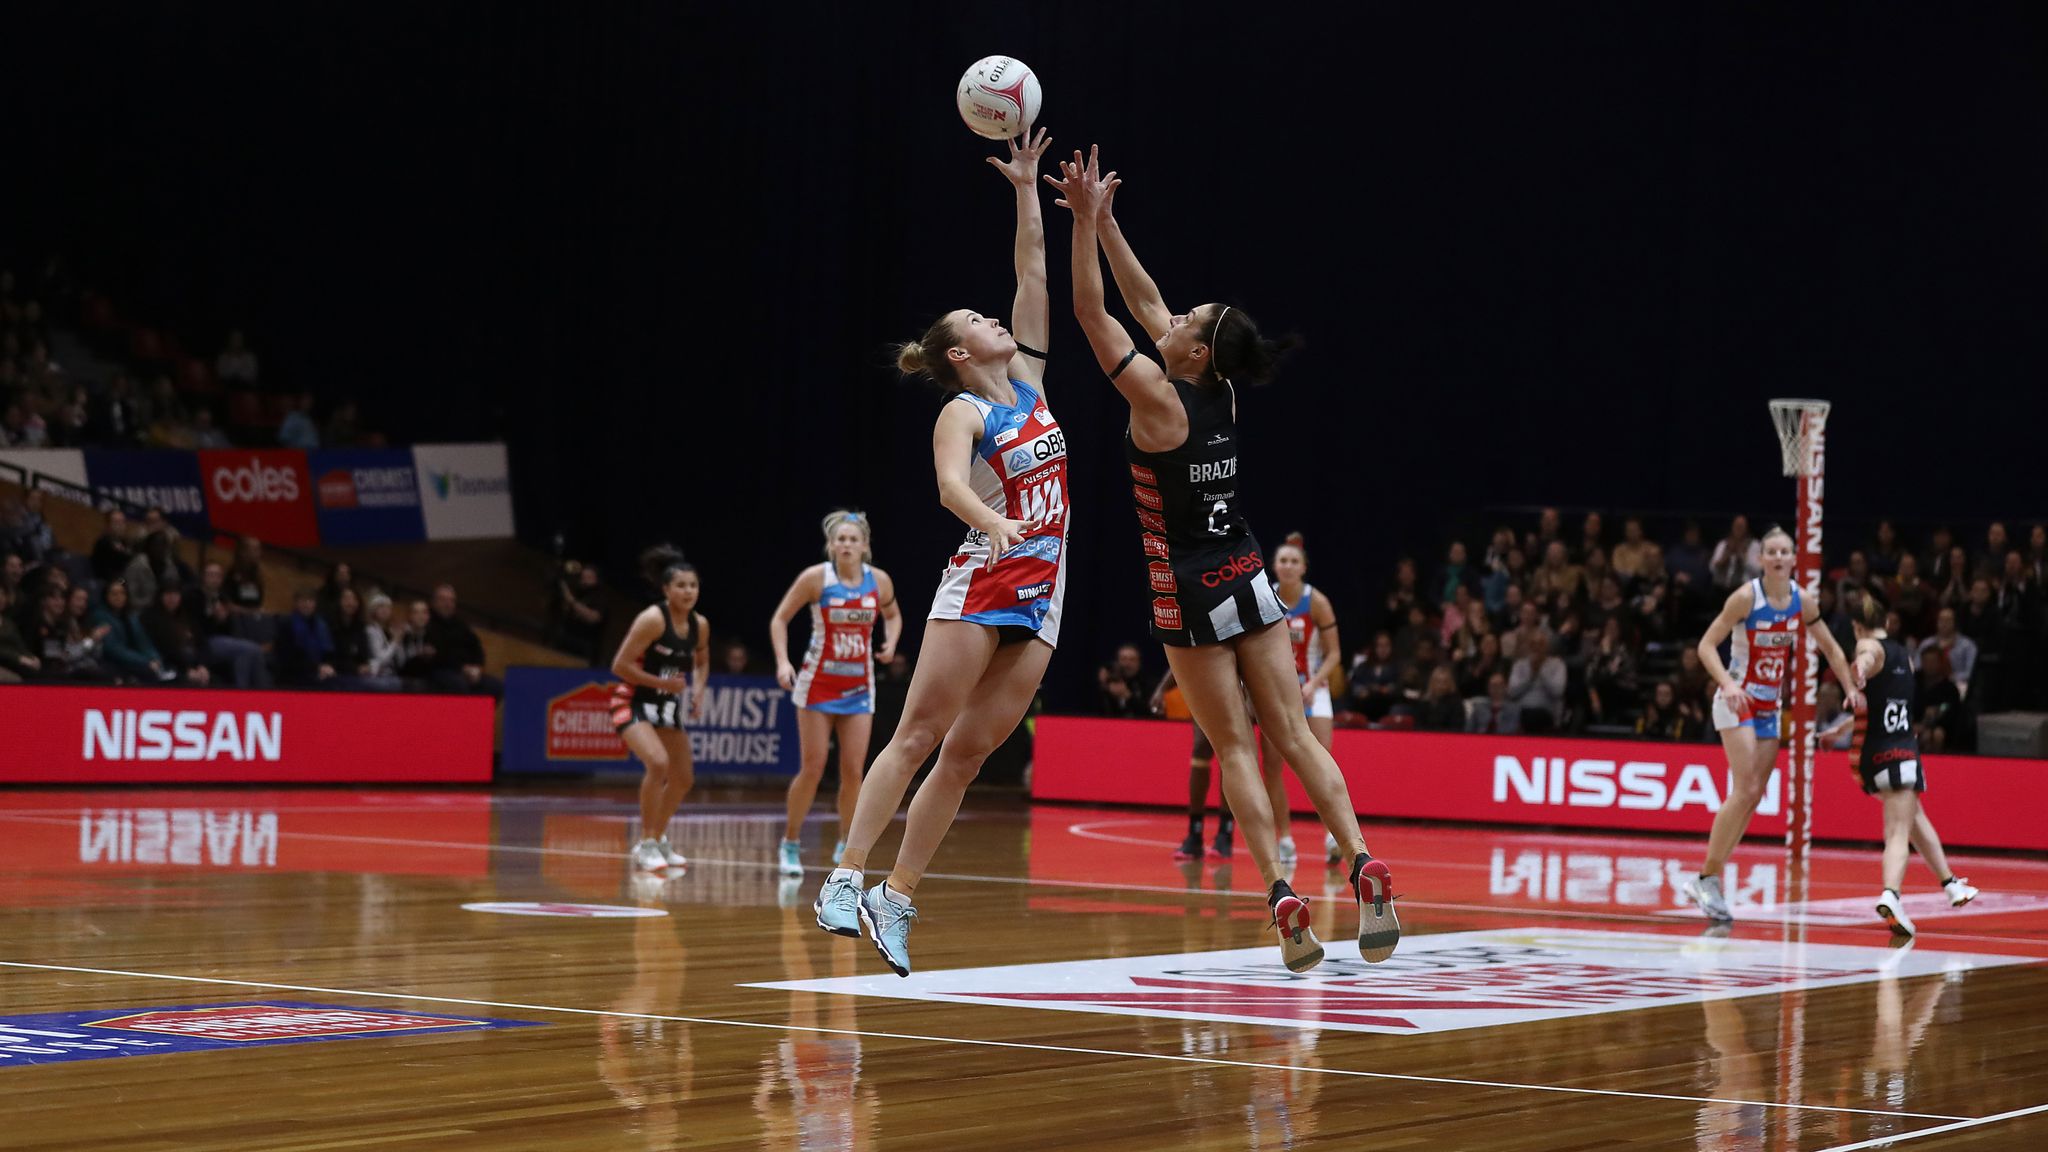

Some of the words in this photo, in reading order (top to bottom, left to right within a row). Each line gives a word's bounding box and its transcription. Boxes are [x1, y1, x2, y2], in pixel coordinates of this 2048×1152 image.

[1033, 431, 1065, 460] QBE
[213, 457, 301, 502] coles
[1023, 464, 1061, 485] NISSAN
[1019, 476, 1065, 534] WA
[1208, 500, 1231, 535] C
[1201, 551, 1264, 588] coles
[679, 687, 787, 730] EMIST
[1884, 702, 1909, 733] GA
[83, 709, 282, 761] NISSAN
[690, 731, 781, 764] EHOUSE
[129, 1012, 394, 1033] CHEMIST
